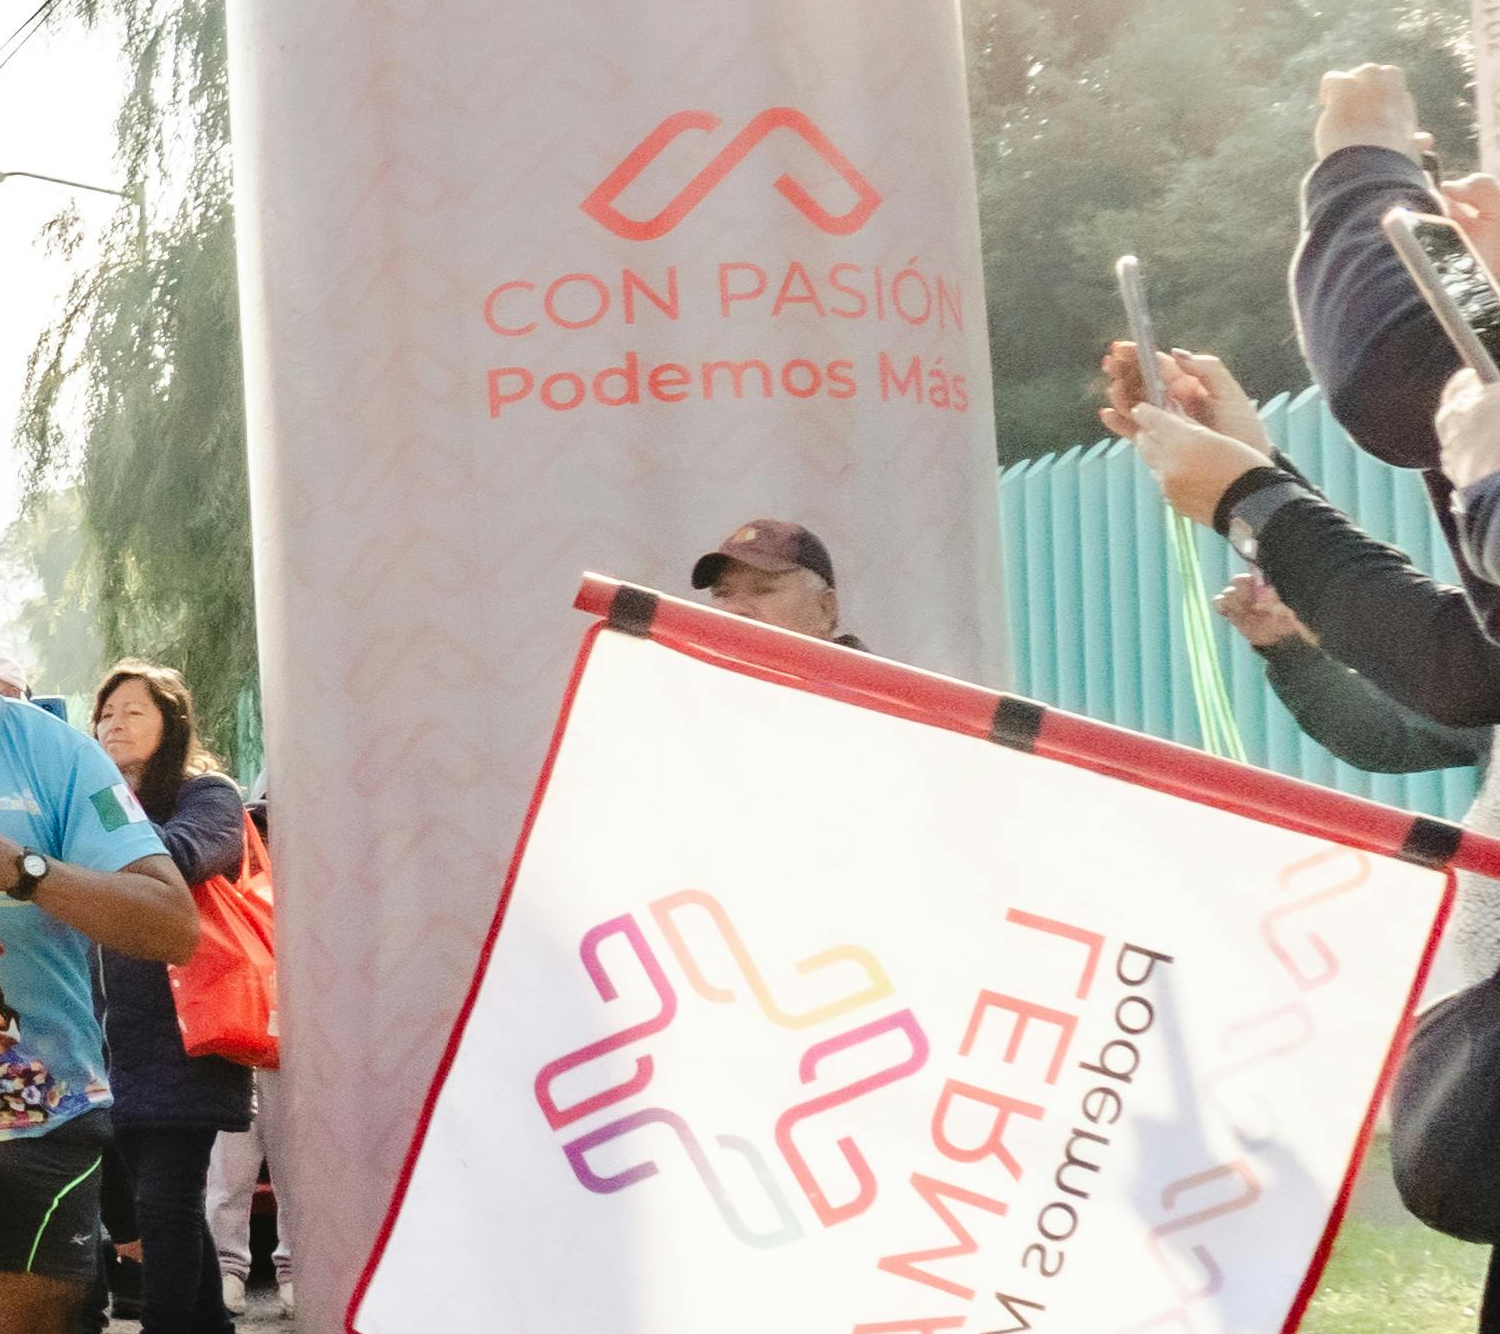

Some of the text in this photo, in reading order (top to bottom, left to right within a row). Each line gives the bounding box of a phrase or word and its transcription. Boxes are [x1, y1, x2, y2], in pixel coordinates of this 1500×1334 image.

[483, 255, 965, 337] CON PASIÓN
[485, 350, 970, 419] Podemos Más
